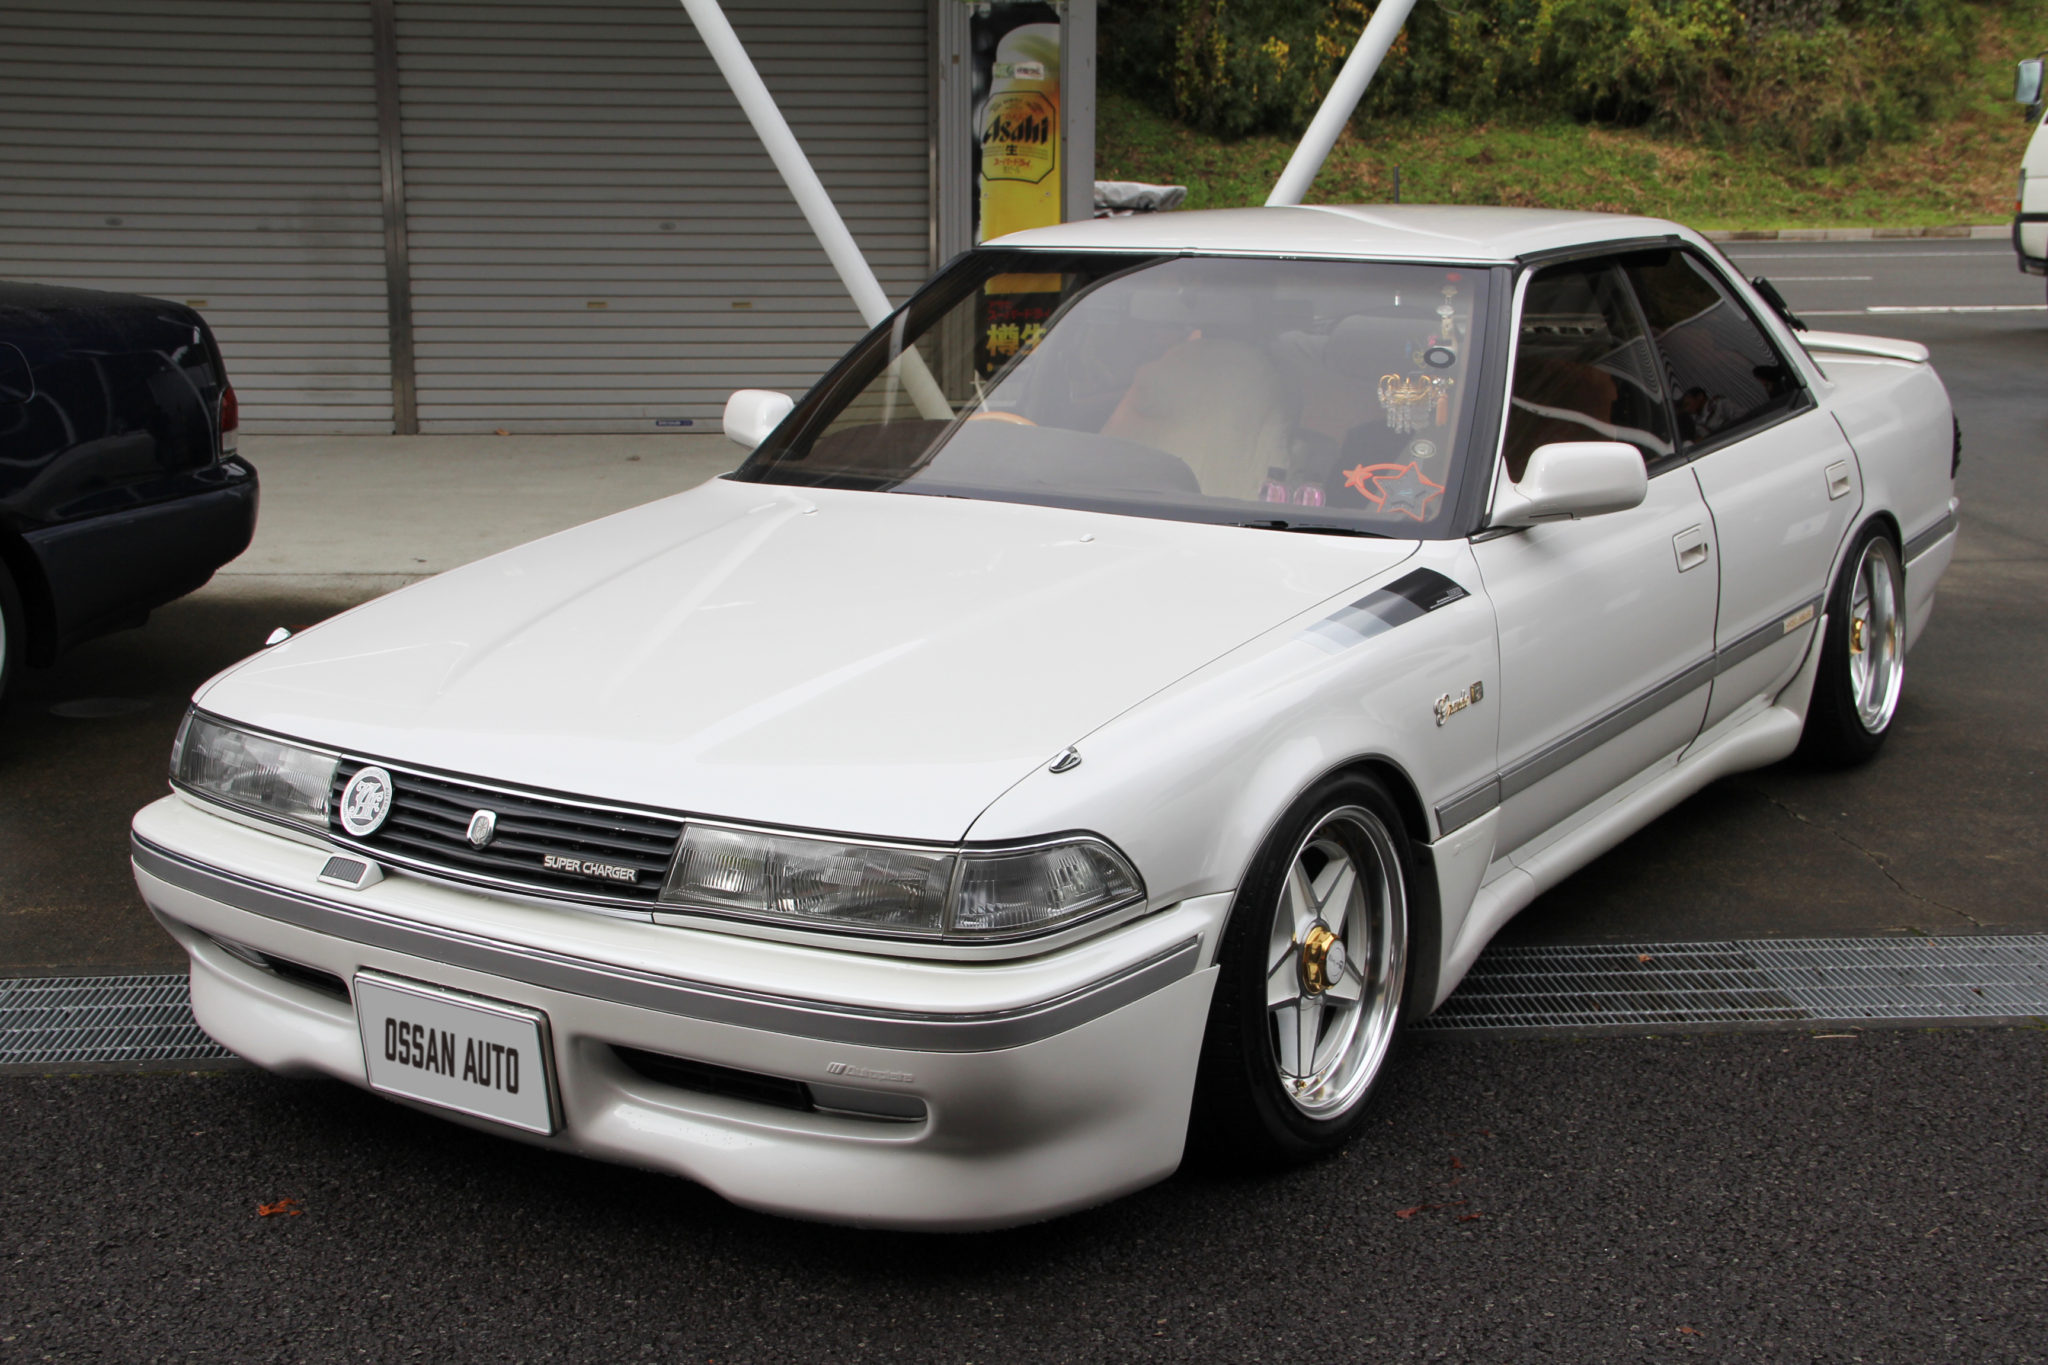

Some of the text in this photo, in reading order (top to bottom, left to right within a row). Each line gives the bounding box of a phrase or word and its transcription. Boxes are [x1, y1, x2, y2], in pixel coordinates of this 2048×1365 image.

[983, 114, 1049, 145] Asahi
[1005, 144, 1018, 156] 生
[543, 855, 637, 882] SUPER CHARGER
[385, 1017, 519, 1095] OSSAN AUTO
